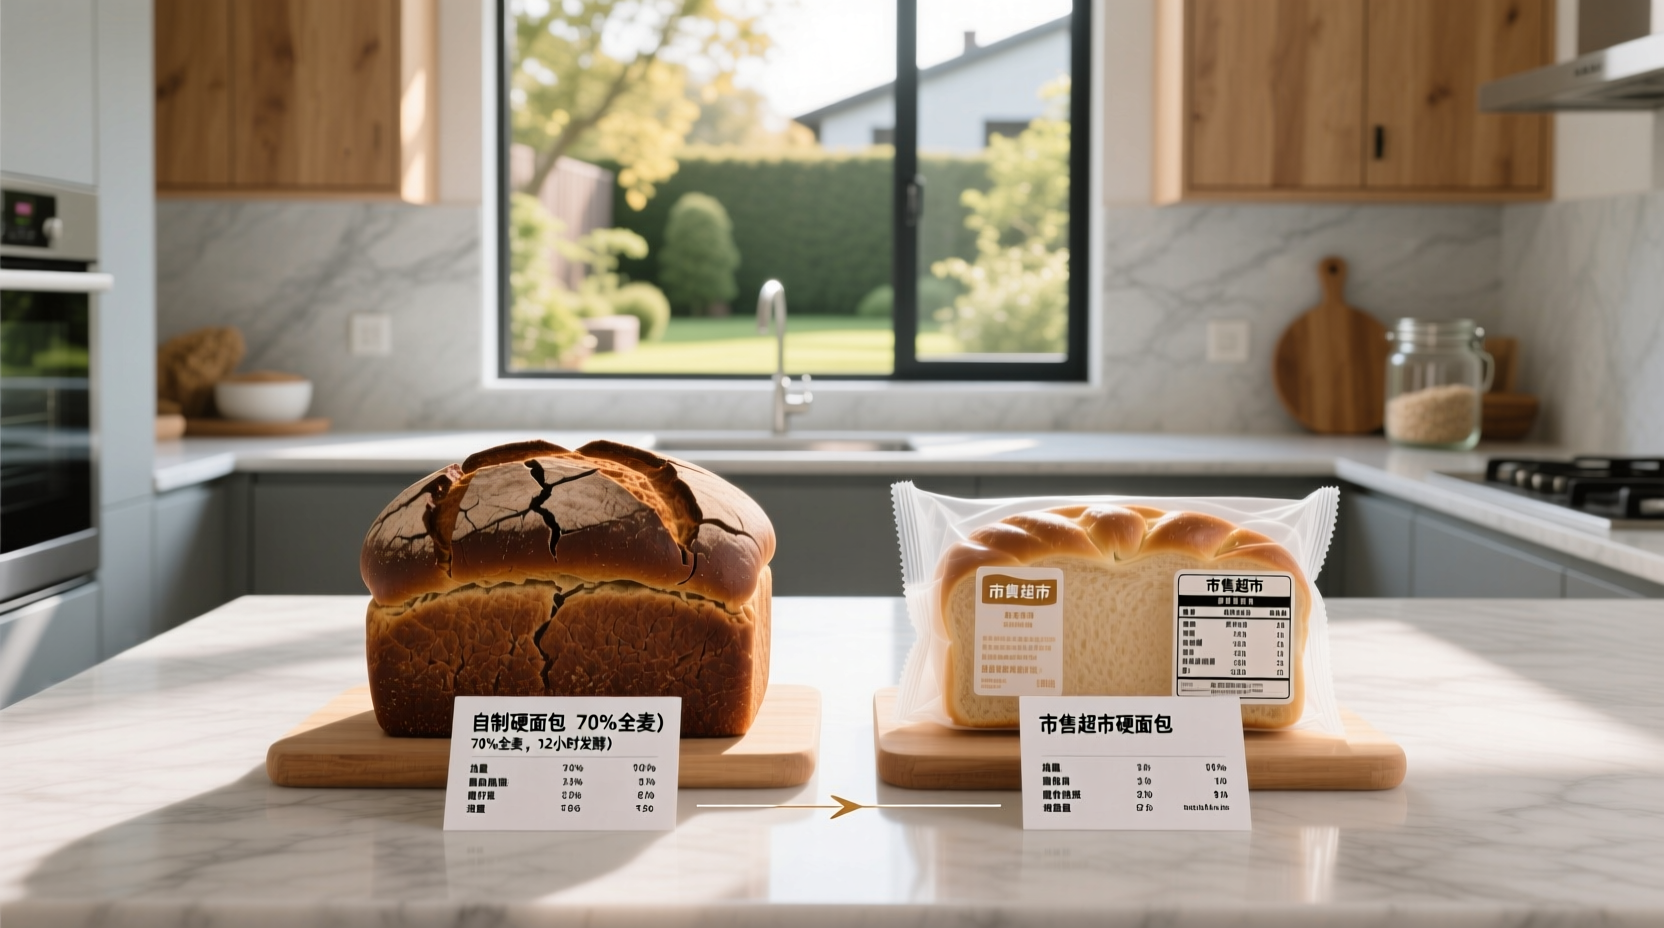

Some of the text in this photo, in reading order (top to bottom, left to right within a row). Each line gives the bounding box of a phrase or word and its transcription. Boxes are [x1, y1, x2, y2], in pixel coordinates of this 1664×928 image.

[473, 712, 566, 733] 自制硬面包
[1039, 713, 1173, 734] 市售超市硬面包
